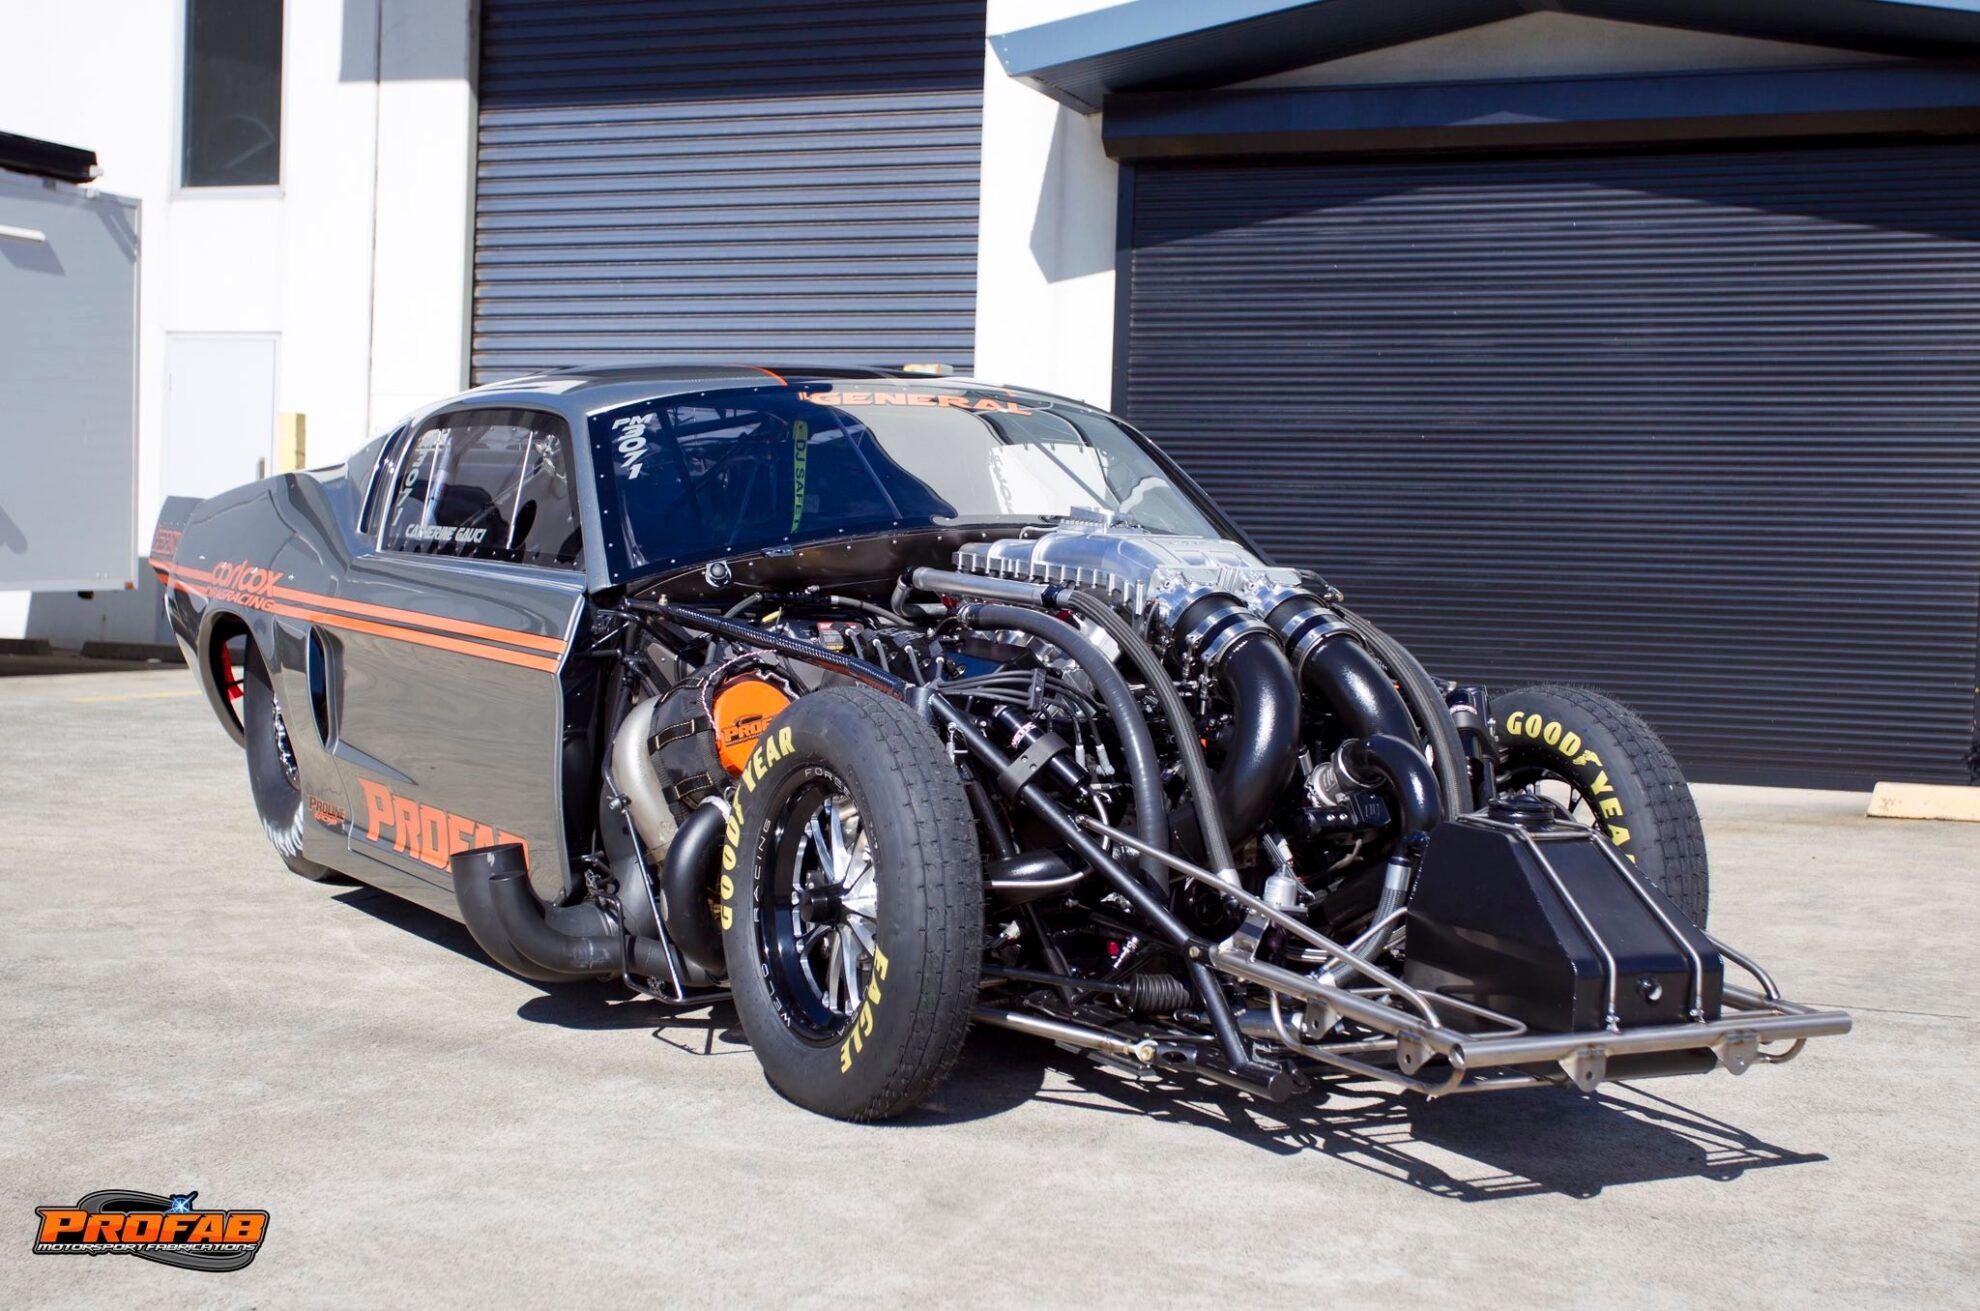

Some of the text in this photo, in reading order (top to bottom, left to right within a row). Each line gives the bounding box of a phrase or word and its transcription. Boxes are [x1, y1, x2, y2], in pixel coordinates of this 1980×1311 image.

[612, 413, 656, 431] PM
[809, 391, 1033, 416] GENERAL
[618, 424, 648, 480] 3071
[721, 718, 773, 742] PROF
[1506, 711, 1637, 864] GOODYEA
[720, 726, 796, 930] GOODYEAR
[753, 818, 771, 922] RACING
[840, 943, 889, 1074] EAGLE
